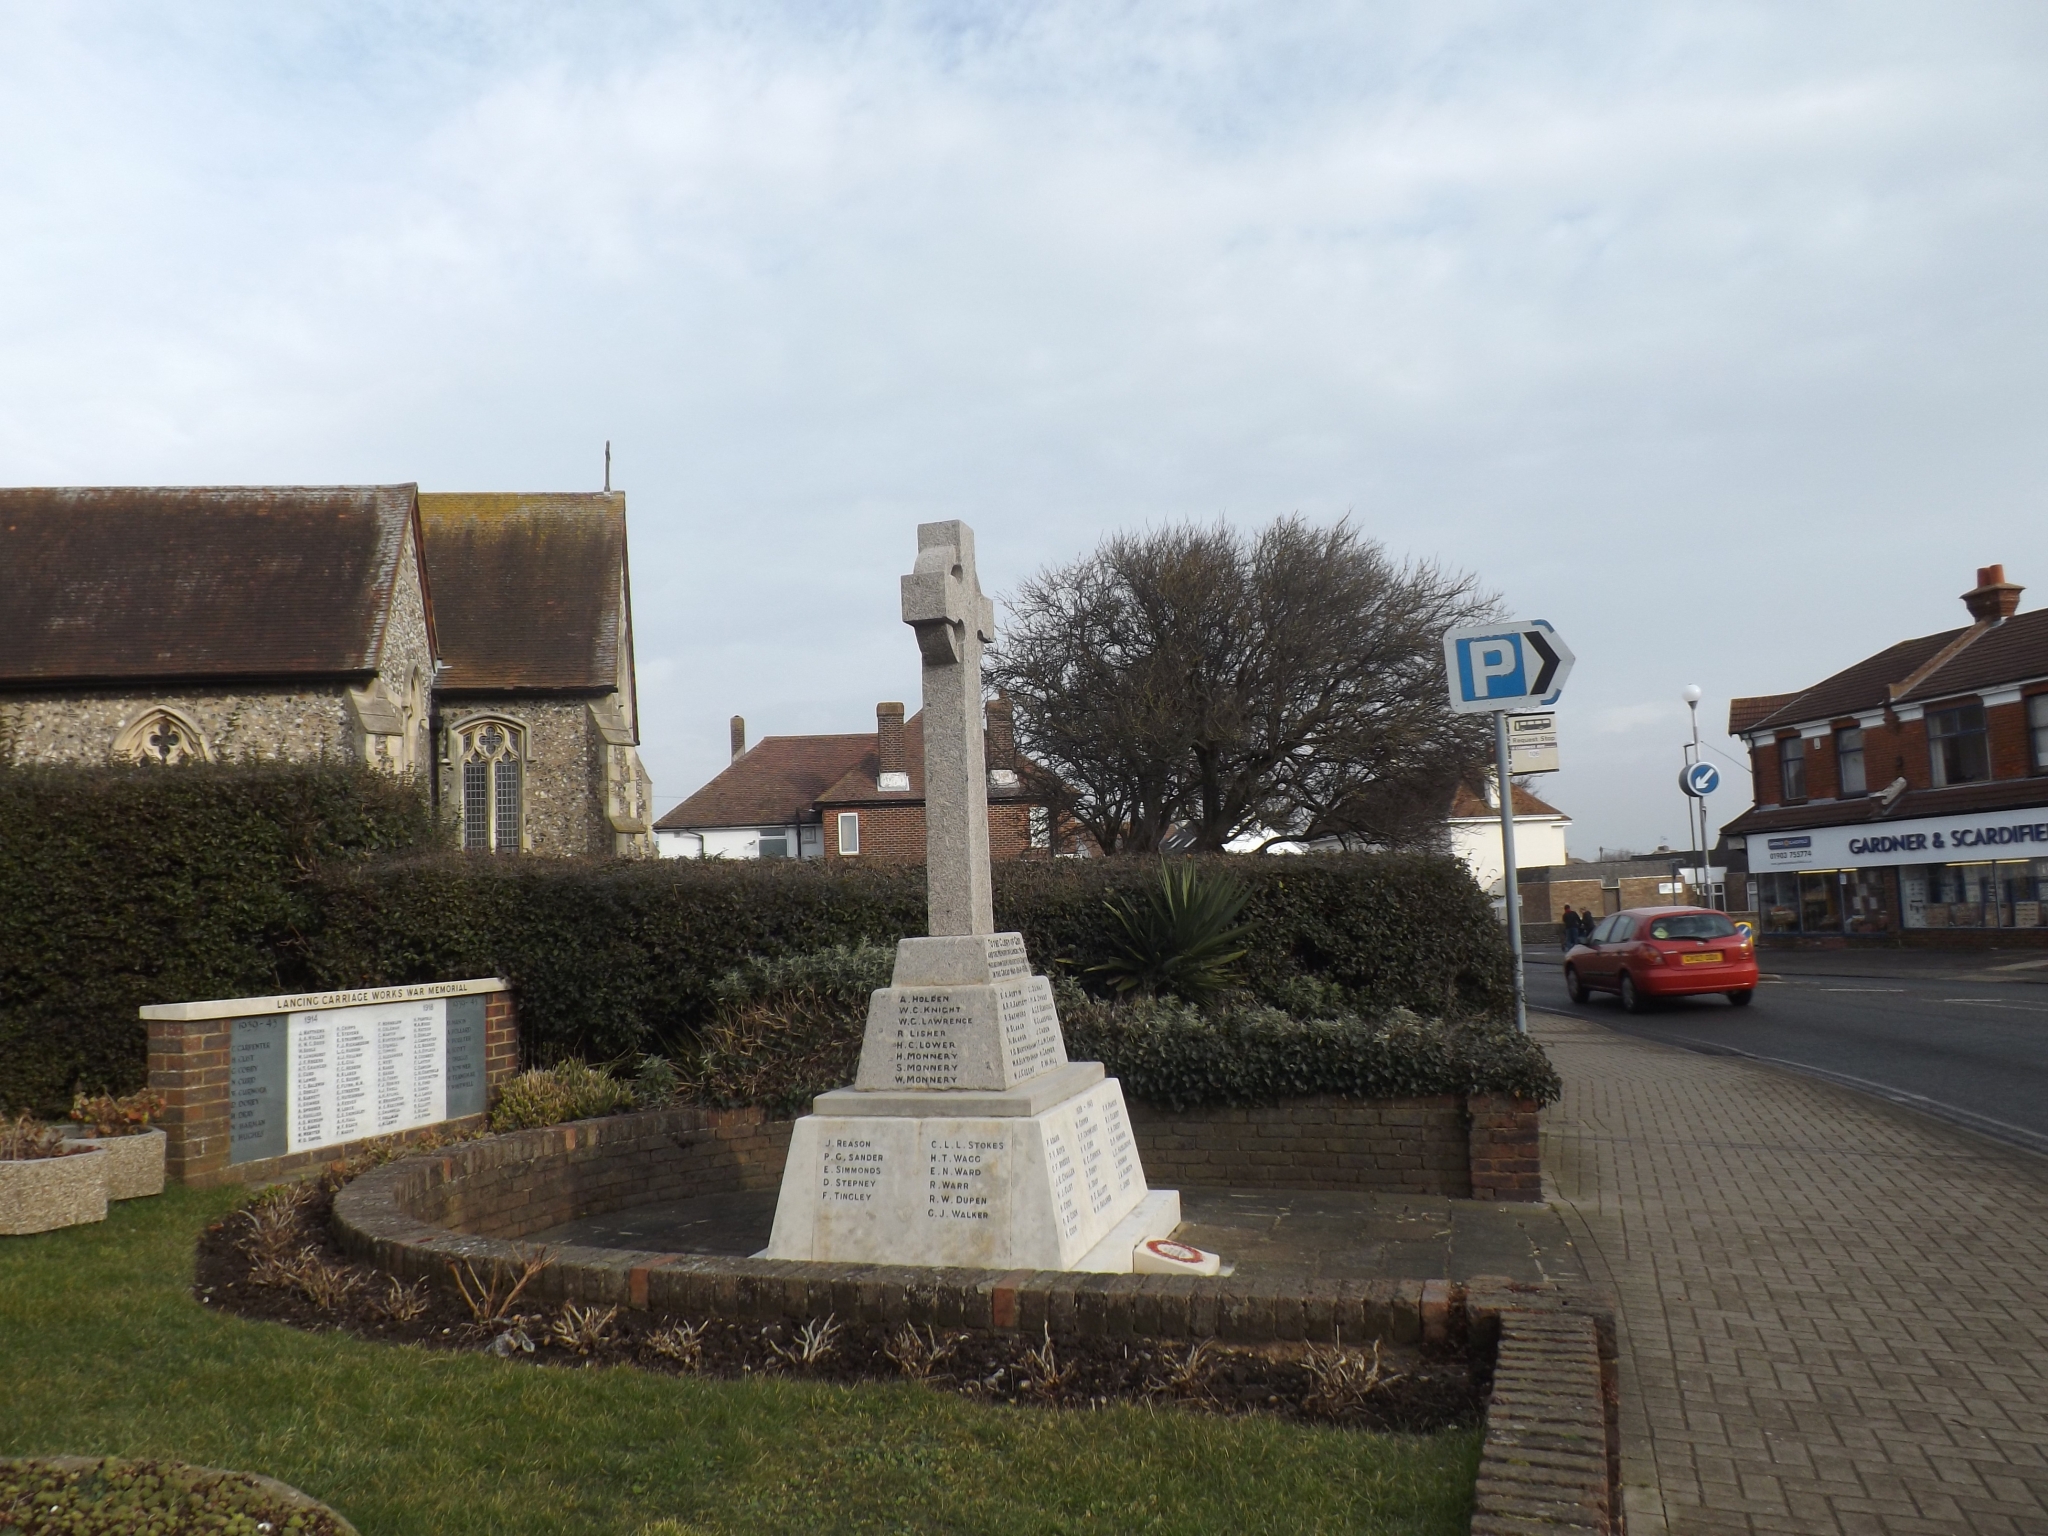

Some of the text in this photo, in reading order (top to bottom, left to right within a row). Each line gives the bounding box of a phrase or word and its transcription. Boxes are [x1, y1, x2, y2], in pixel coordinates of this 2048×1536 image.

[1469, 639, 1517, 698] P
[1849, 823, 2048, 854] GARDNER & SCARDIFIE
[277, 984, 468, 1009] LANCING CARRIAGE WORKS WAR MEMORIAL
[304, 1015, 318, 1023] 1914
[836, 1140, 871, 1148] REASON
[968, 1142, 1004, 1150] STOKES
[953, 1155, 981, 1163] WAGG
[836, 1166, 881, 1174] SIMMONDS
[954, 1168, 982, 1176] WARD
[835, 1178, 876, 1187] STEPNEY
[942, 1181, 969, 1190] WARR
[834, 1192, 872, 1201] TINGLEY
[956, 1196, 987, 1205] DUPEN
[952, 1210, 989, 1219] WALKER
